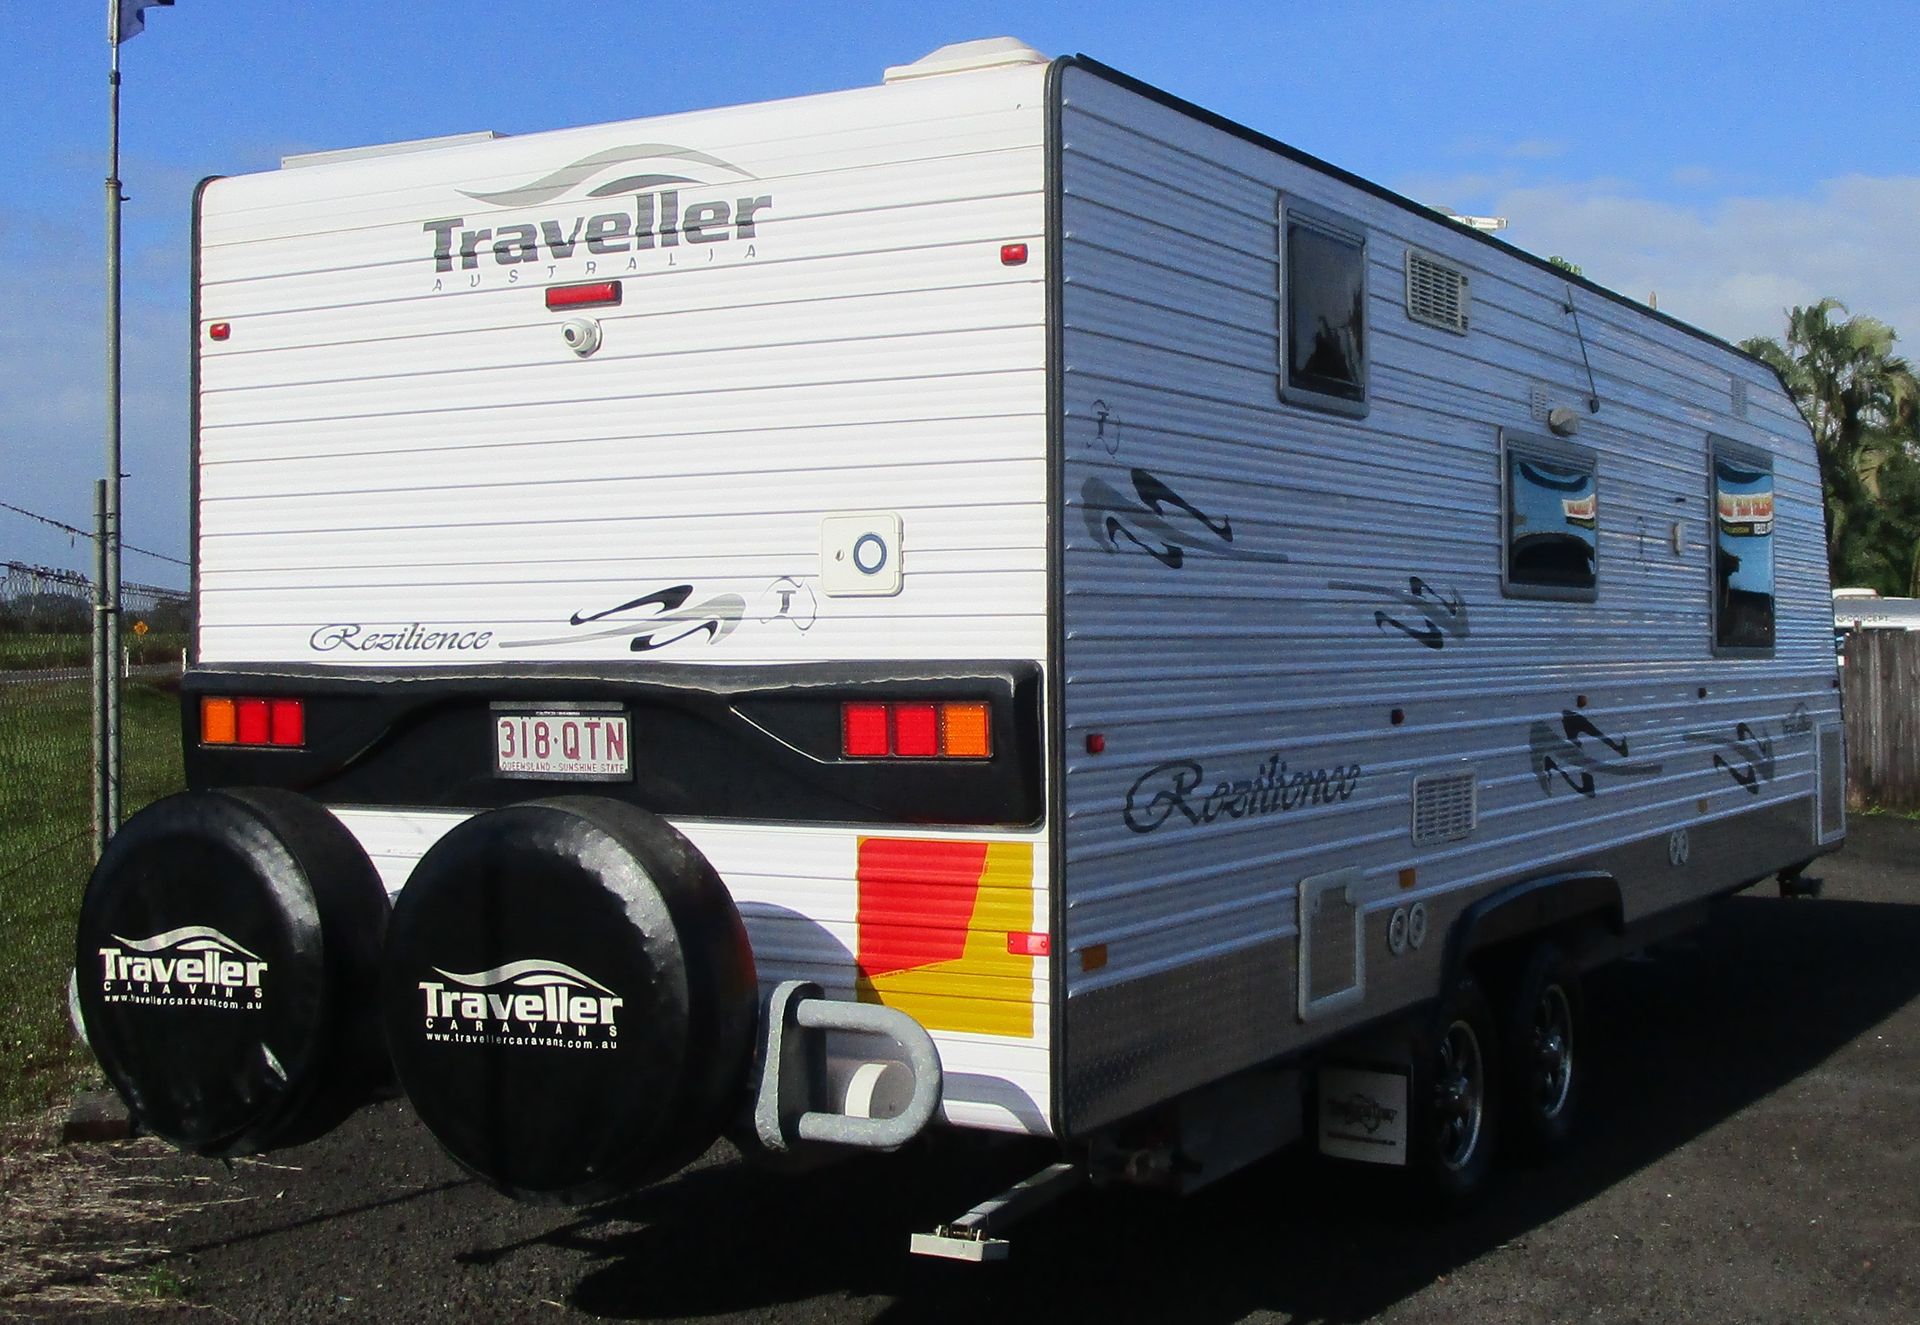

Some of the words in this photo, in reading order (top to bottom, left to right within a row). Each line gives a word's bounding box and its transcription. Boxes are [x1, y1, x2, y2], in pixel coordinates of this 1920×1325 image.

[423, 190, 772, 273] Traveller
[432, 243, 757, 292] AUSTRALIA
[310, 623, 493, 651] Rezilience
[501, 762, 550, 771] QUEENSLAND
[559, 763, 597, 772] SUNSHINE
[601, 763, 624, 773] STATE
[99, 948, 268, 987] Traveller
[104, 981, 263, 998] CARAVANS
[418, 981, 623, 1025] Traveller
[425, 1018, 618, 1037] CARAVANS
[426, 1032, 617, 1049] www.travellercaravans.com.au
